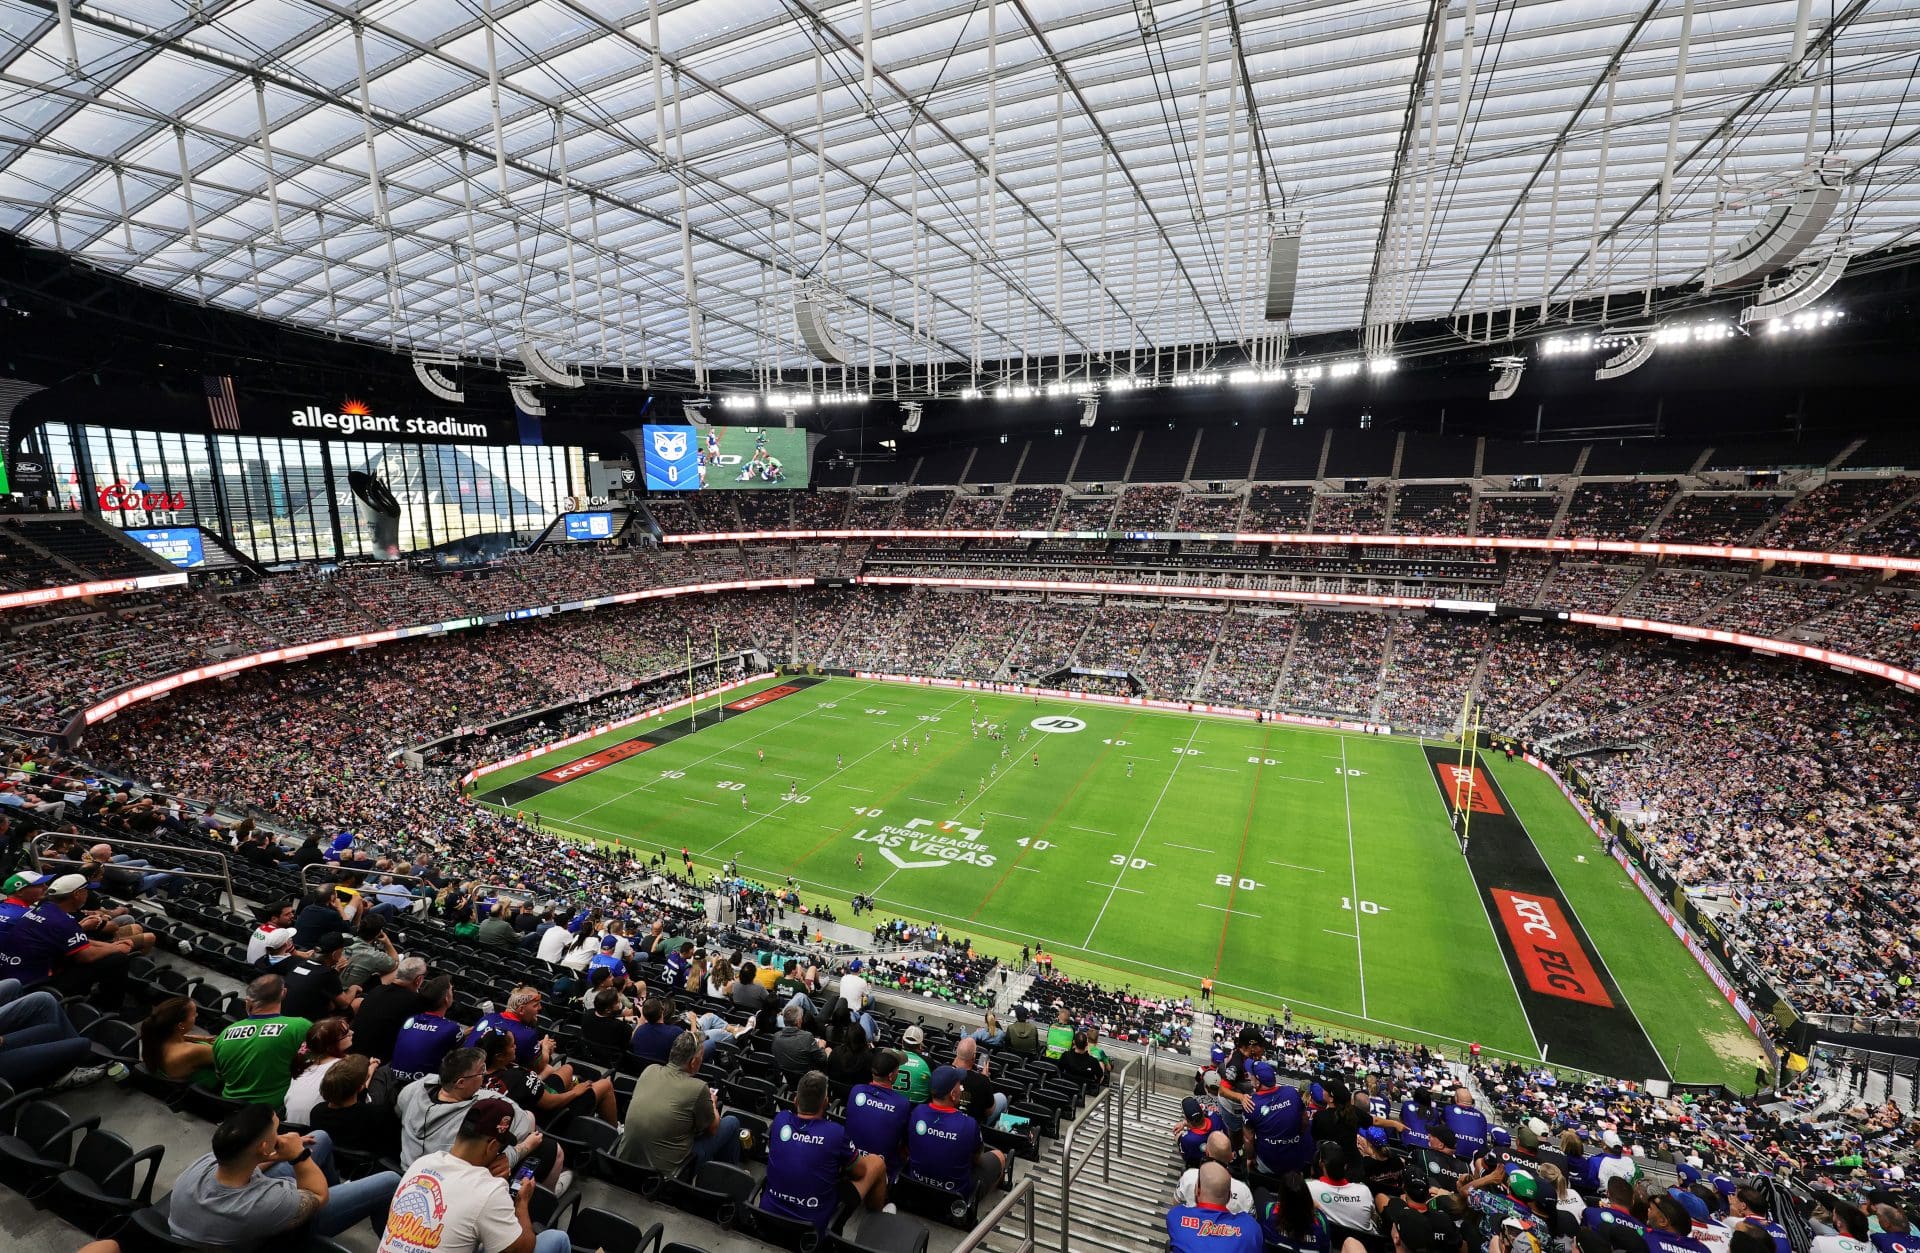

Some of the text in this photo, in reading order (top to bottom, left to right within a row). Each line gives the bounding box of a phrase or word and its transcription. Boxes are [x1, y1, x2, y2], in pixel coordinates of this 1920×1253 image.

[291, 406, 488, 438] allegiant stadium
[668, 465, 679, 482] 0
[95, 484, 186, 511] Coors
[1038, 719, 1079, 731] JD
[1102, 738, 1127, 746] 40
[1171, 747, 1199, 756] 30
[1247, 756, 1277, 766] 20
[553, 759, 601, 779] KFC
[1334, 766, 1361, 777] 10
[716, 781, 746, 791] 20
[854, 806, 884, 818] 40
[879, 825, 989, 853] RUGBY LEAGUE
[1016, 836, 1050, 851] 40
[852, 828, 998, 867] LAS VEGAS
[1109, 854, 1147, 869] 30
[1215, 873, 1257, 891] 20
[1341, 896, 1380, 915] 10
[1510, 896, 1558, 940] KFC
[662, 965, 678, 985] 25
[223, 1023, 288, 1040] VIDEO EZY
[866, 1099, 896, 1113] one.nz
[792, 1133, 825, 1146] one.nz
[927, 1127, 958, 1141] one.nz
[1434, 1232, 1446, 1241] RT
